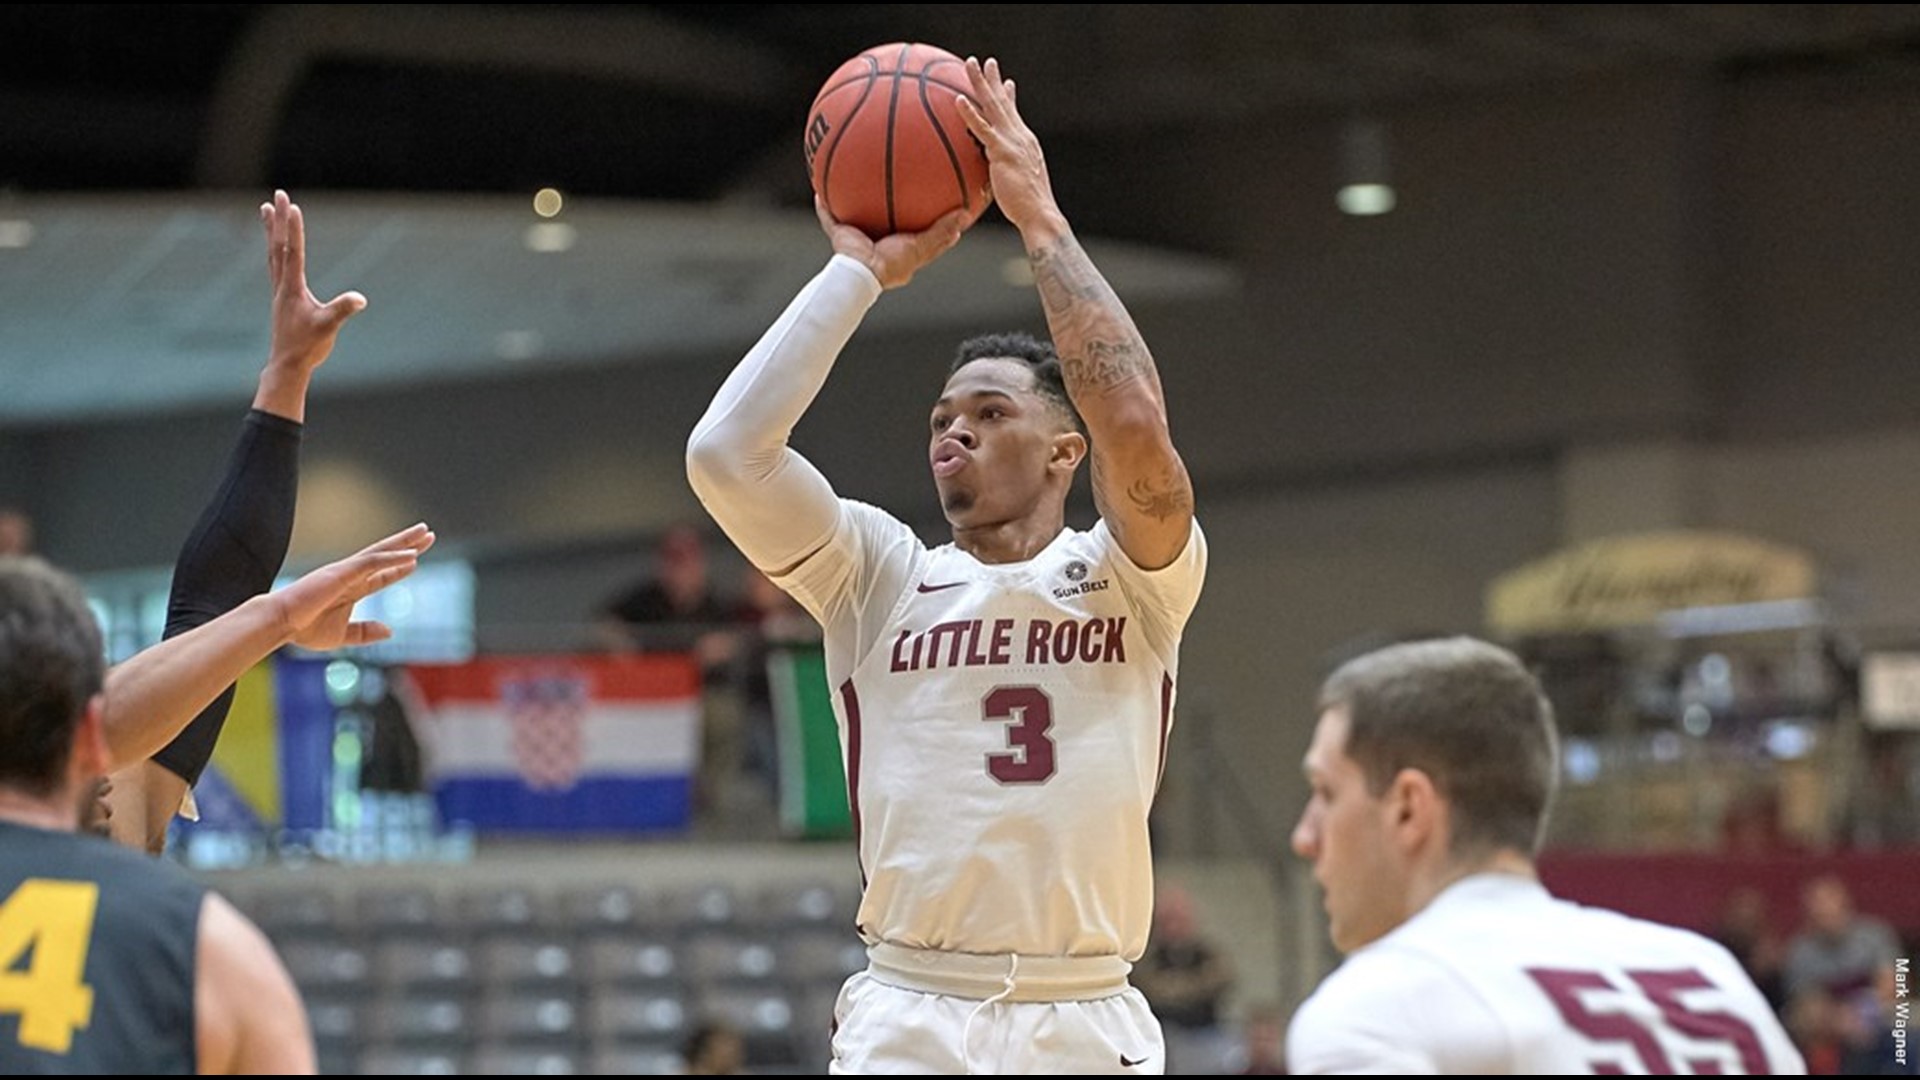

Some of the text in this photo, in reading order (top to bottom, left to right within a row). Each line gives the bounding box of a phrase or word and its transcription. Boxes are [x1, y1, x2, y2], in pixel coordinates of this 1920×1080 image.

[1052, 579, 1109, 599] SUN BELT
[889, 616, 1127, 673] LITTLE ROCK
[981, 683, 1058, 787] 3
[0, 877, 98, 1055] 4
[1522, 966, 1771, 1076] 55
